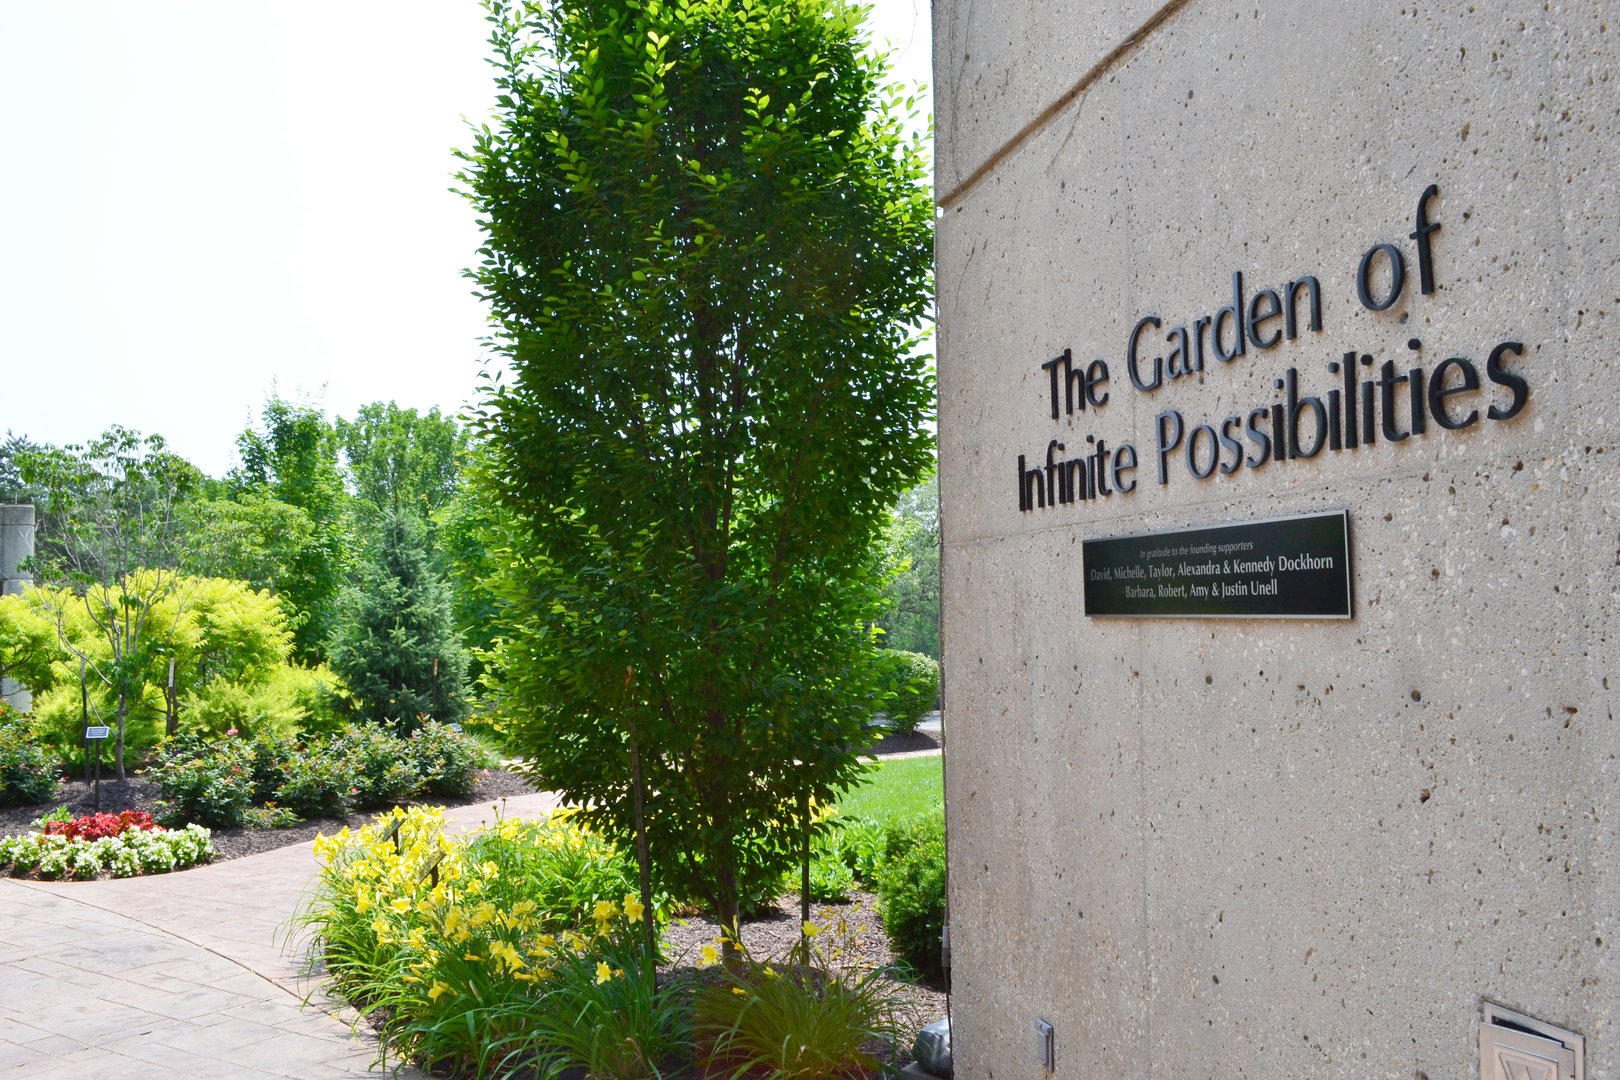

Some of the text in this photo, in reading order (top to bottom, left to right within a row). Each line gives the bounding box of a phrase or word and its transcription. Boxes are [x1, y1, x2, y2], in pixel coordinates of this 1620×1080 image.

[1041, 184, 1442, 420] The Garden of
[1017, 338, 1530, 512] Infinite Possibilities
[1146, 547, 1171, 561] gratitude
[1171, 547, 1179, 556] to
[1179, 545, 1189, 556] the
[1189, 543, 1217, 556] founding
[1217, 541, 1254, 555] supporters
[1090, 552, 1334, 582] David, Michelle, Taylor, Alexandra & Kennedy Dockhorn
[1125, 578, 1278, 600] Barbara, Robert, Amy & Justin Unell
